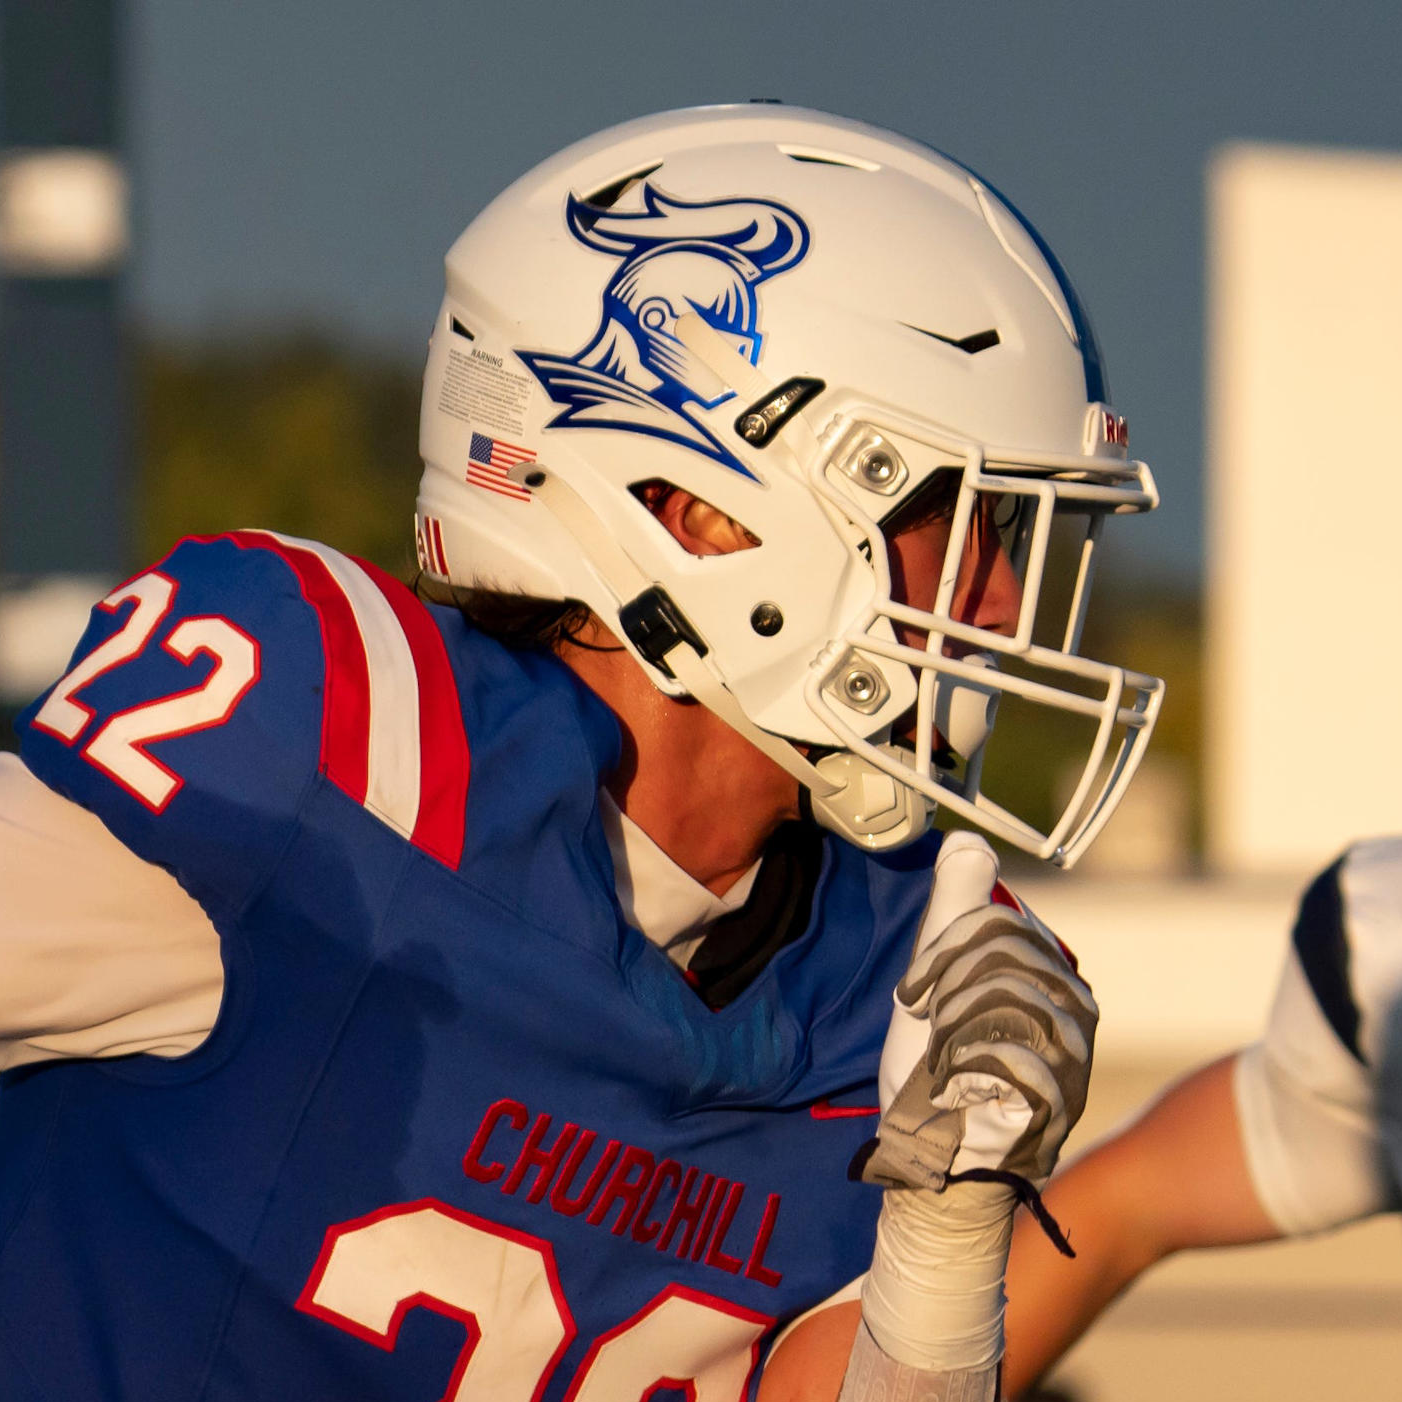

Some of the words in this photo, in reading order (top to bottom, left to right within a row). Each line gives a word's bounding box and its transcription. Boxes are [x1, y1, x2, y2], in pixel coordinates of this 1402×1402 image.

[471, 349, 504, 368] WARNING
[31, 570, 261, 815] 22
[462, 1097, 784, 1287] CHURCHILL
